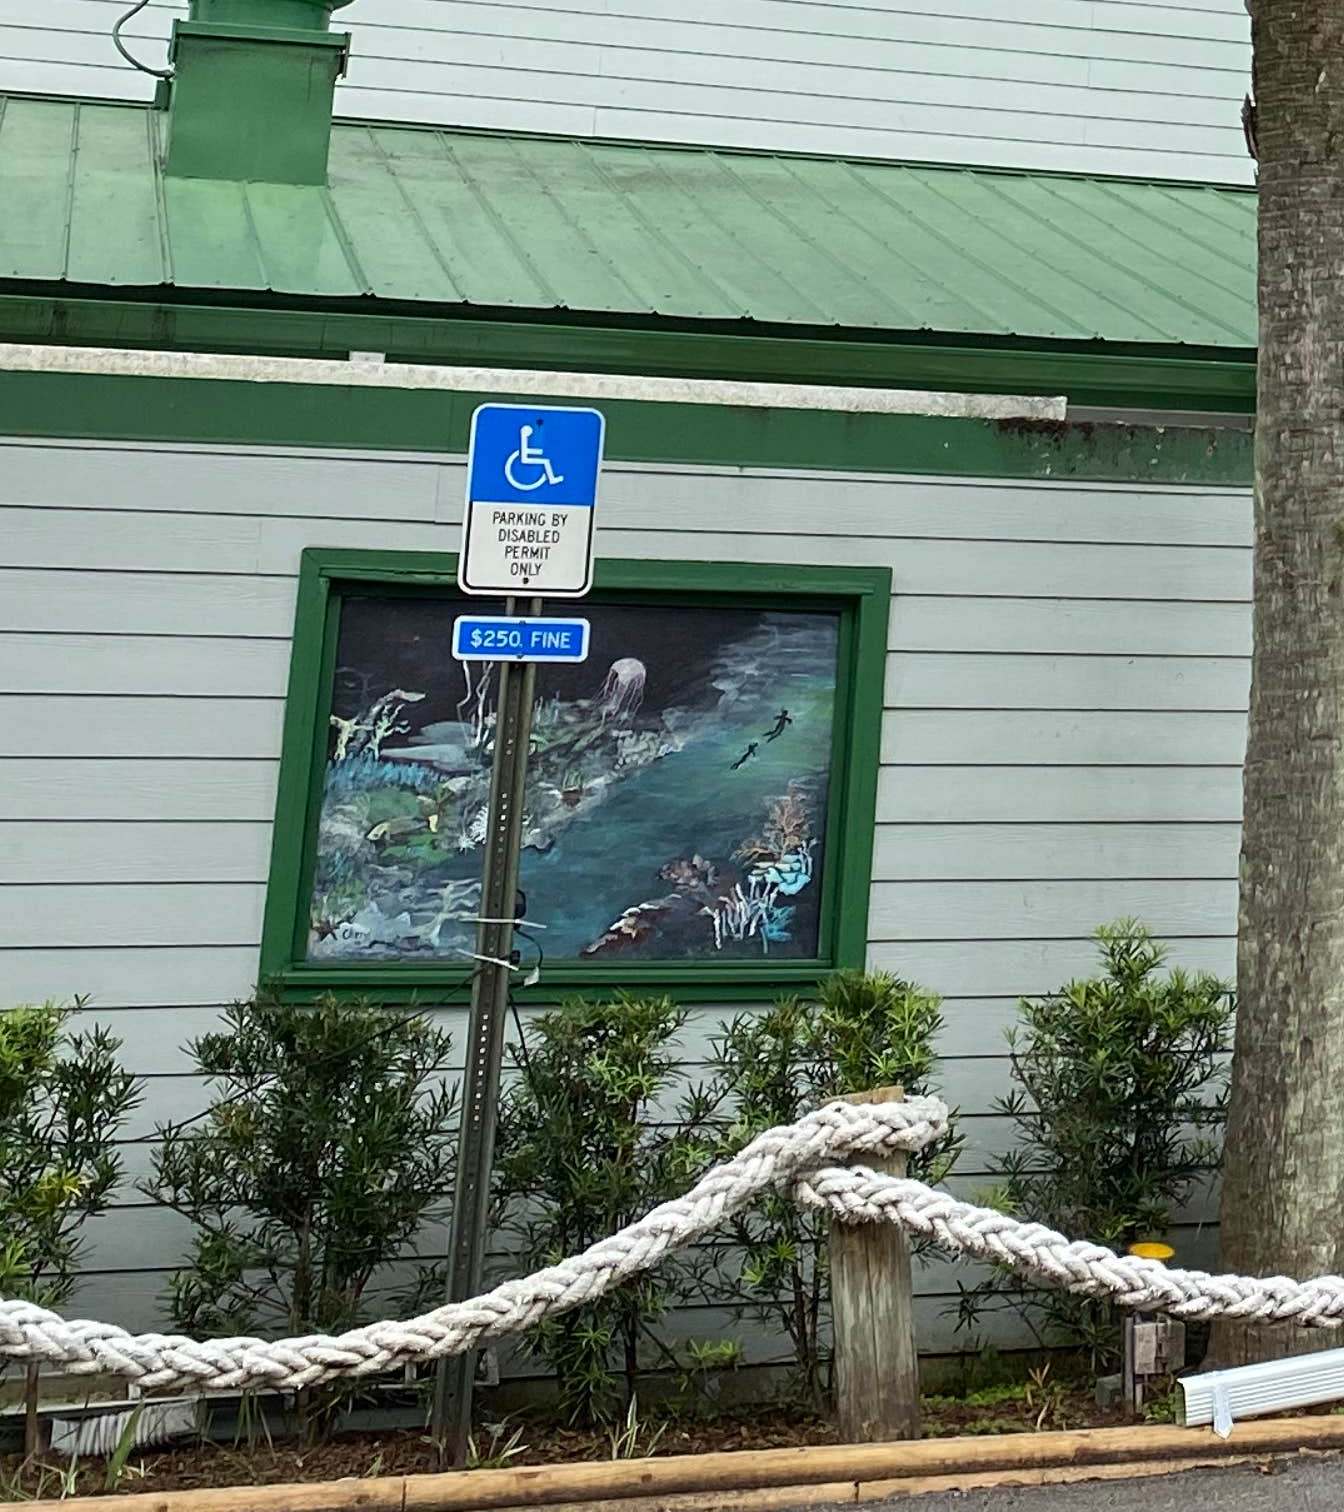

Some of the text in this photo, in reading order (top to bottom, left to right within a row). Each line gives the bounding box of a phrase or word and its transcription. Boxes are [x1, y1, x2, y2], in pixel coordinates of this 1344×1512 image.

[492, 511, 568, 528] PARKING BY
[498, 529, 560, 544] DISABLED
[504, 546, 551, 560] PERMIT
[510, 562, 543, 576] ONLY
[530, 631, 571, 649] FINE
